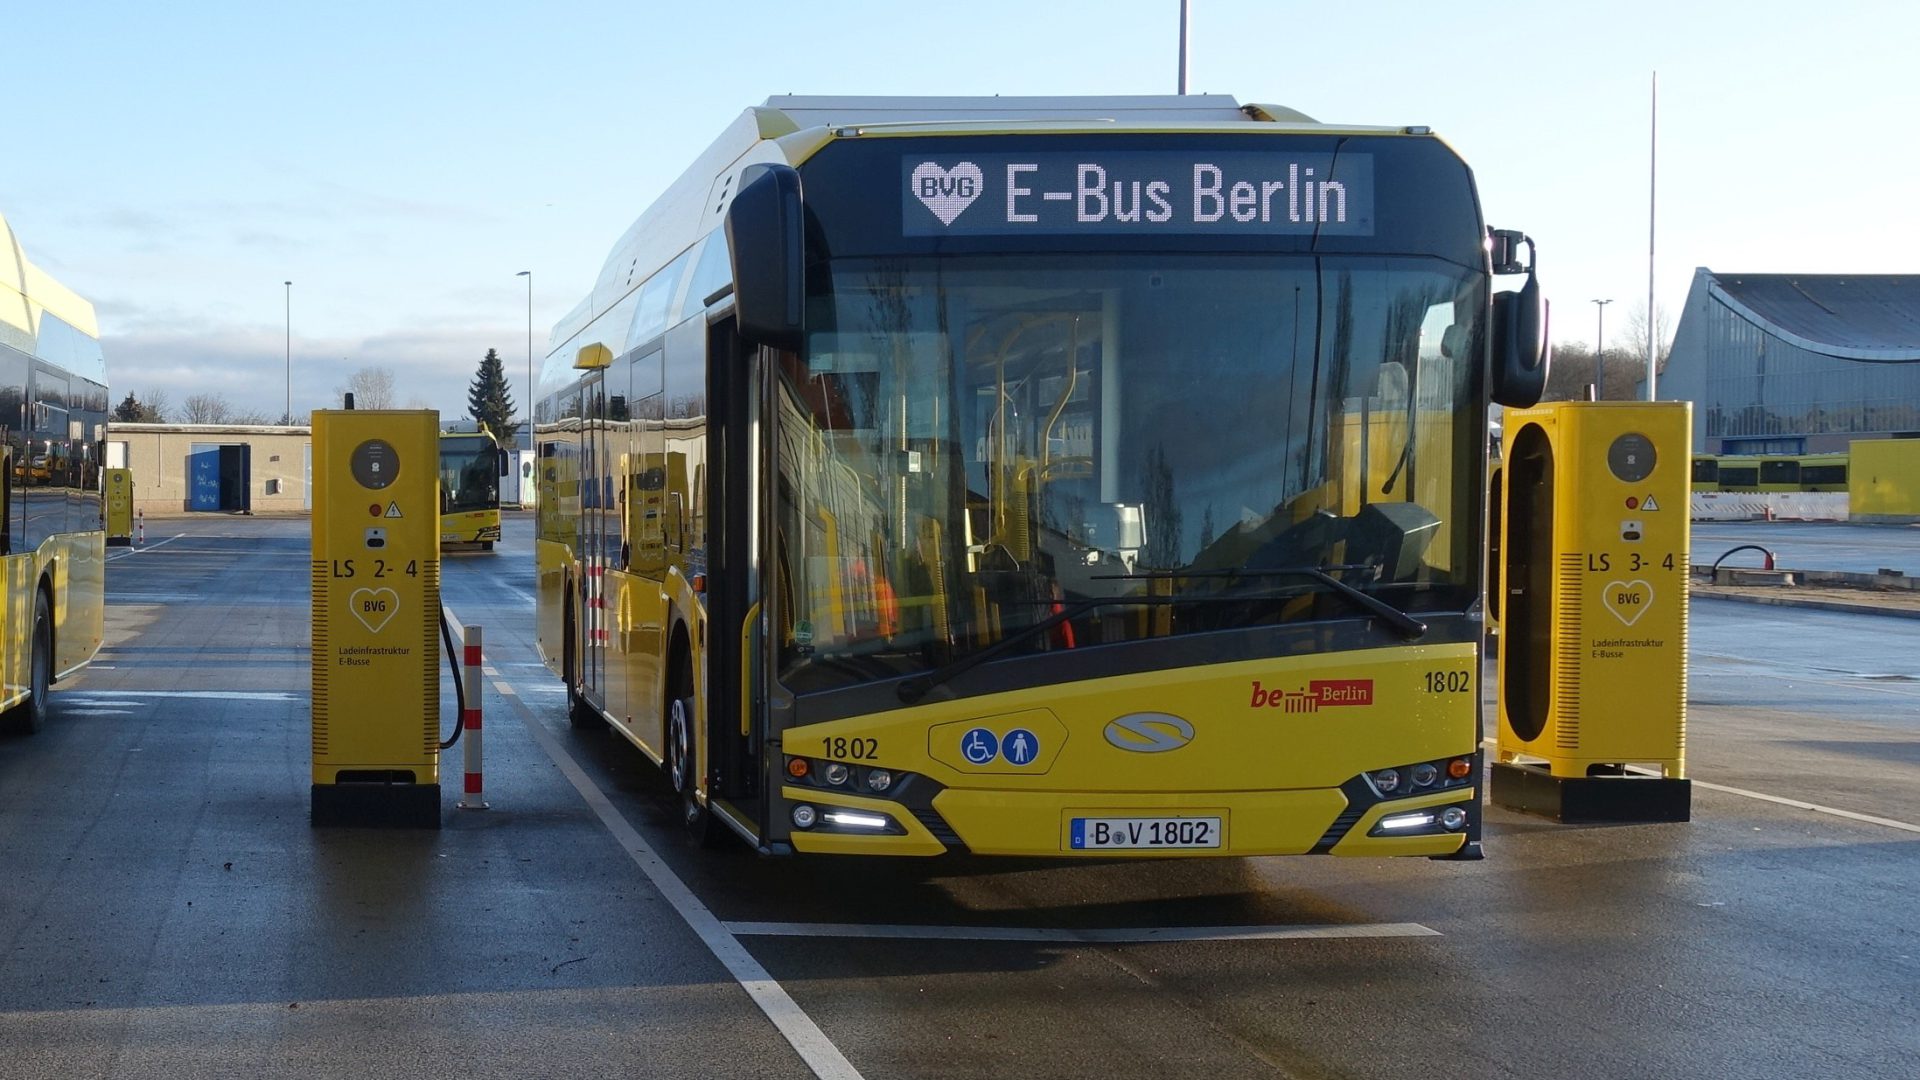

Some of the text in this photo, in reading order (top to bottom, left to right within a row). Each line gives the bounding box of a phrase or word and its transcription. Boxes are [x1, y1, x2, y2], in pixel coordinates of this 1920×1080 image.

[920, 176, 975, 199] BVG
[1006, 163, 1346, 222] E-Bus Berlin
[333, 560, 354, 577] LS
[405, 560, 417, 577] 4
[1588, 554, 1609, 571] LS
[1662, 554, 1673, 571] 4
[364, 600, 386, 612] BVG
[1617, 592, 1640, 605] BVG
[339, 646, 410, 656] Ladeinfrastruktur
[1592, 638, 1664, 648] Ladeinfrastruktur
[339, 657, 370, 666] E-Busse
[1592, 649, 1624, 659] E-Busse
[1425, 670, 1469, 693] 1802
[1250, 681, 1368, 708] be Berlin
[822, 736, 878, 760] 1802
[1095, 821, 1209, 845] B V 1802
